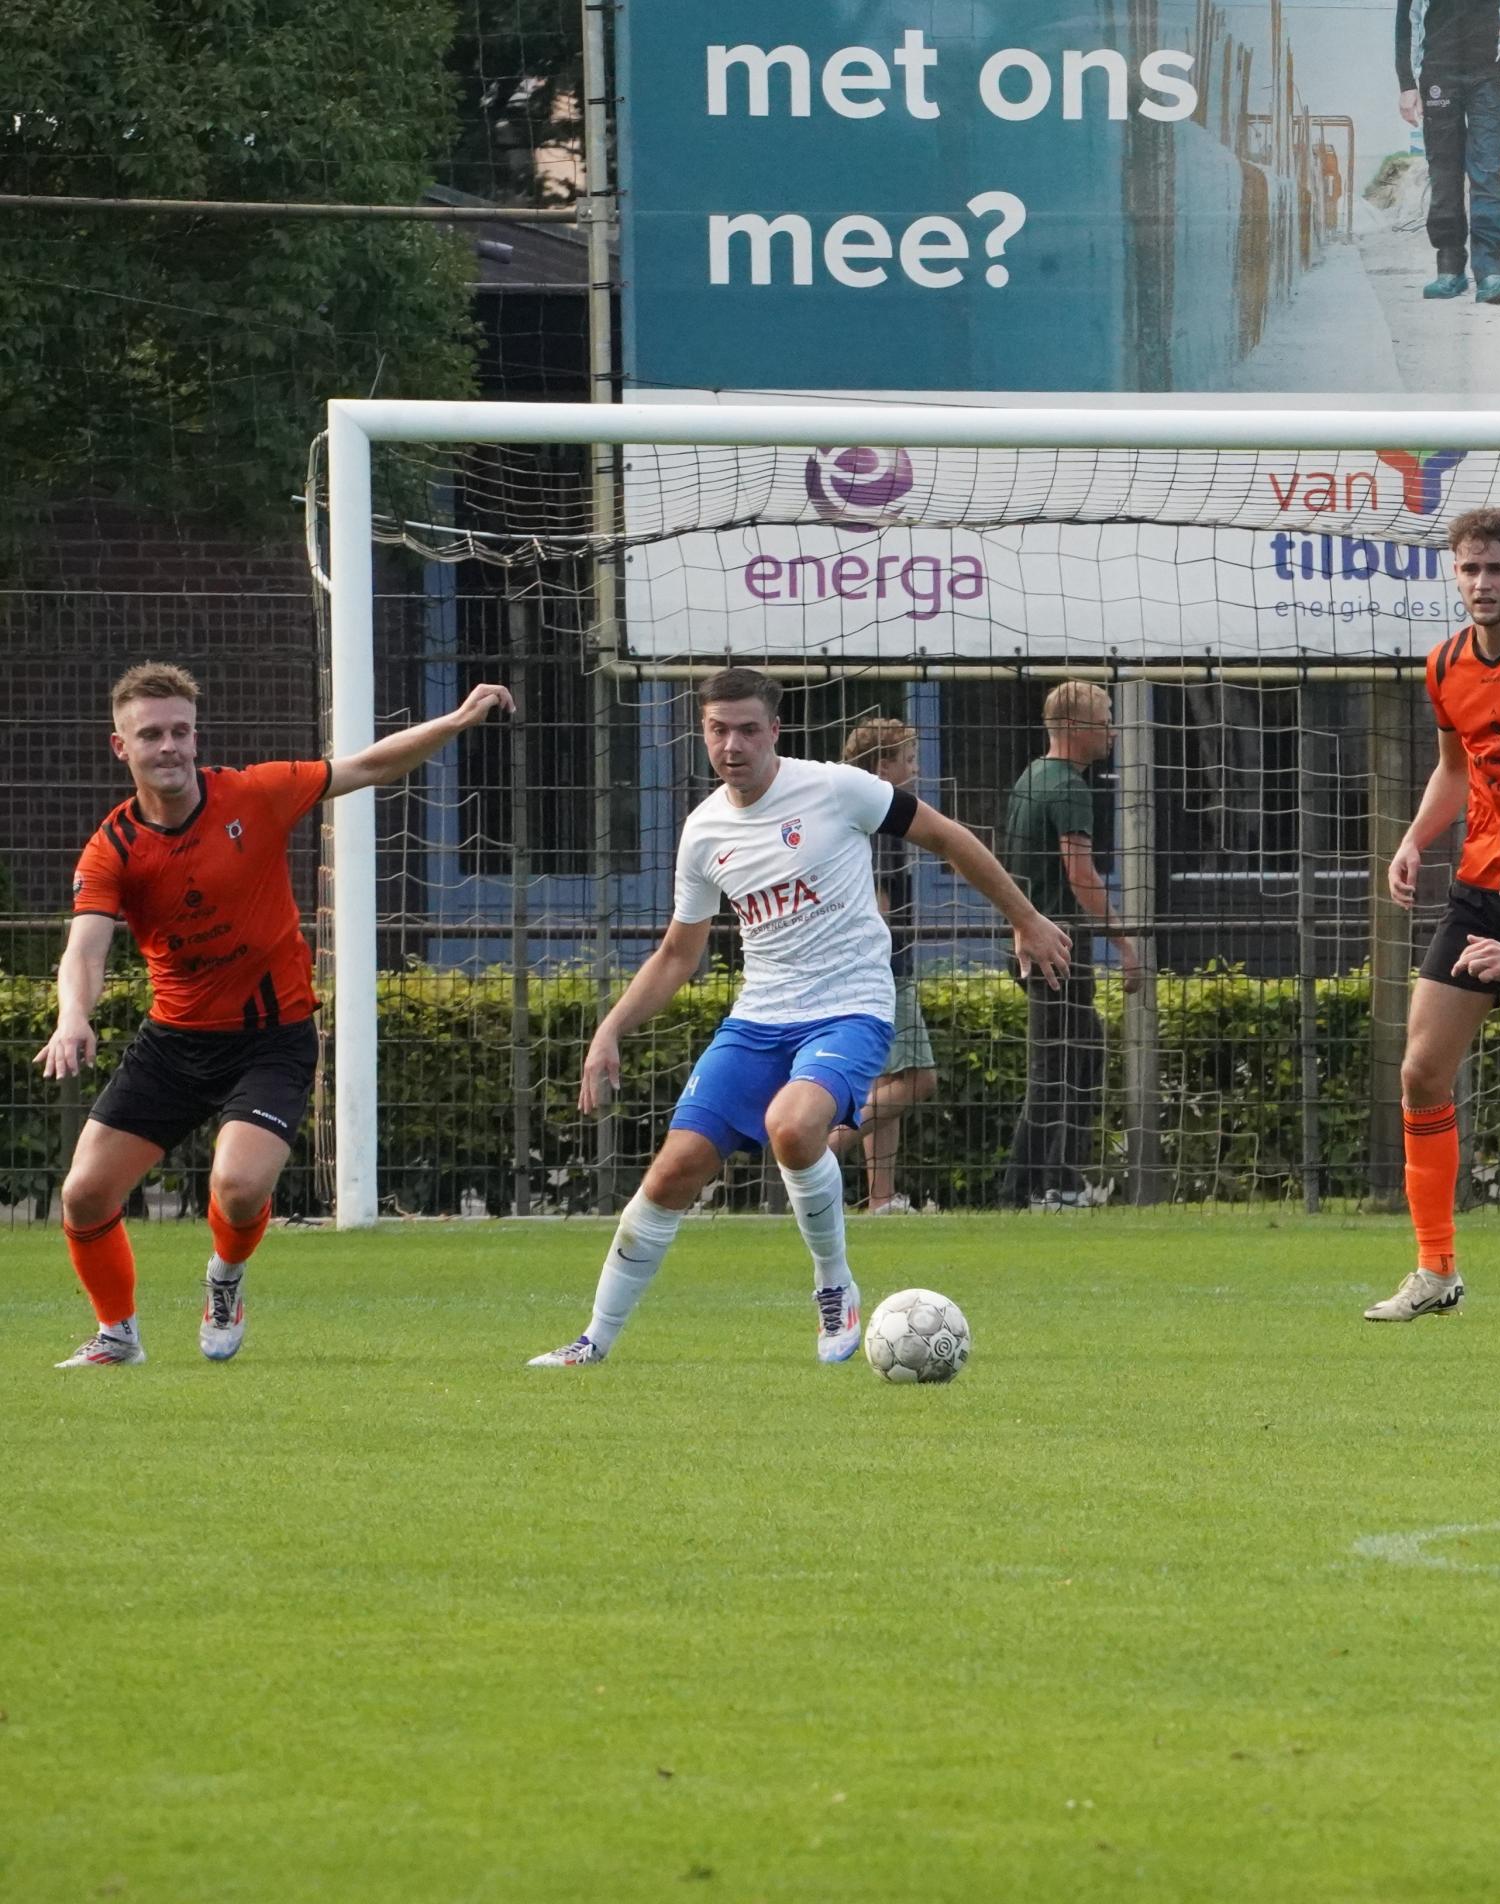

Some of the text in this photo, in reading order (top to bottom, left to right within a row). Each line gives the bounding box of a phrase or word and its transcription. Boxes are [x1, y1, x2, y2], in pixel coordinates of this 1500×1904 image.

[706, 30, 1198, 121] met ons
[709, 191, 1026, 288] mee?
[1269, 472, 1378, 512] van
[1270, 531, 1441, 581] tilbur
[744, 554, 984, 620] energa
[1275, 596, 1380, 623] energie
